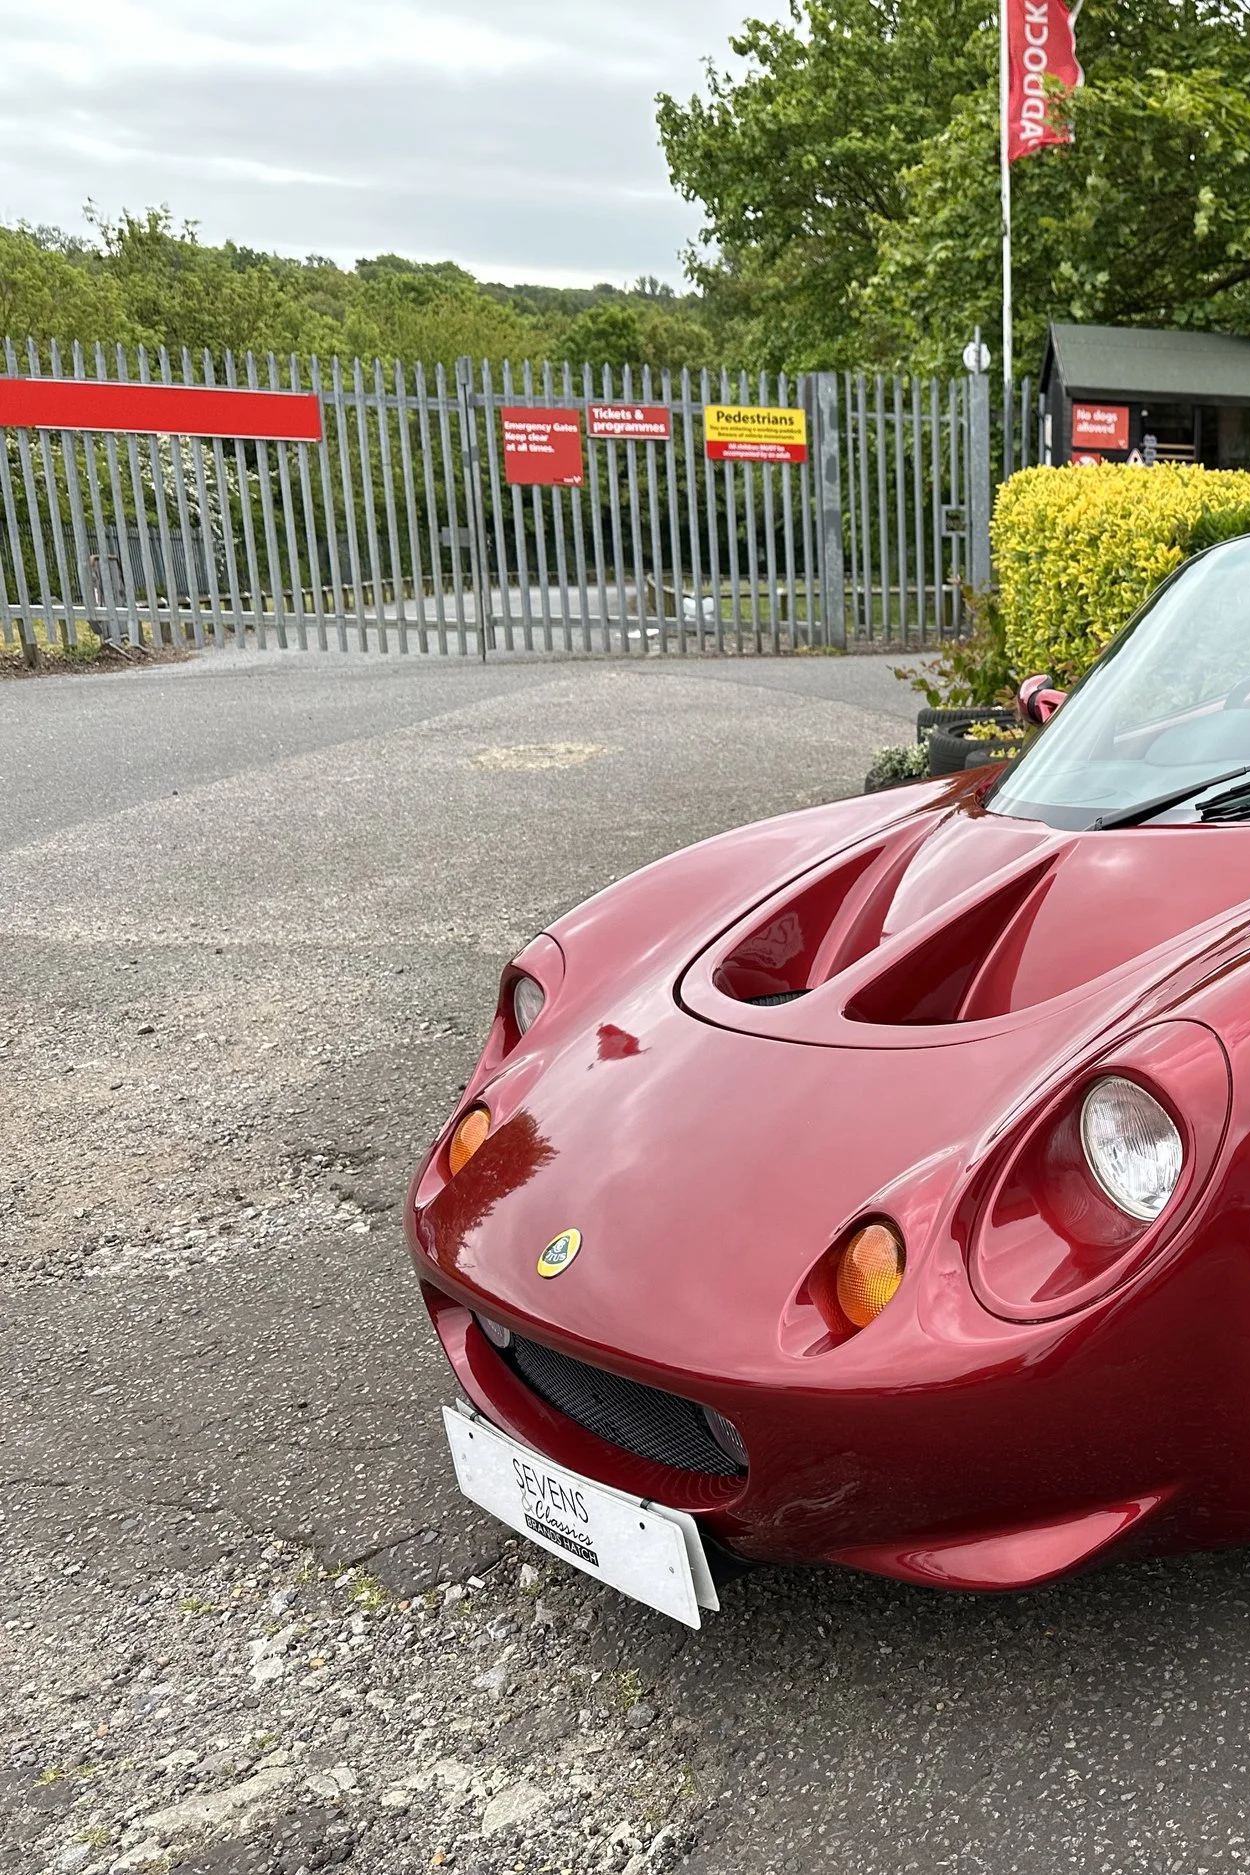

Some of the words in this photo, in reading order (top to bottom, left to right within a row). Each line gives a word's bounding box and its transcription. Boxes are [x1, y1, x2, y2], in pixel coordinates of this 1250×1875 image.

[1019, 0, 1048, 147] ADDOCK
[592, 407, 632, 420] Tickets
[634, 408, 644, 421] &
[716, 410, 794, 426] Pedestrians
[1077, 409, 1091, 420] No
[1093, 409, 1118, 424] dogs
[504, 420, 552, 433] Emergency
[553, 422, 578, 433] Gates
[593, 421, 666, 434] programmes
[1077, 422, 1115, 434] allowed
[504, 431, 527, 442] Keep
[527, 432, 549, 442] clear
[505, 443, 516, 452] at
[517, 442, 528, 452] all
[528, 443, 555, 453] times.
[513, 1458, 589, 1523] SEVENS
[519, 1487, 536, 1515] &
[535, 1500, 593, 1546] Classics
[527, 1515, 562, 1546] BRANDS
[563, 1537, 598, 1566] HATCH
